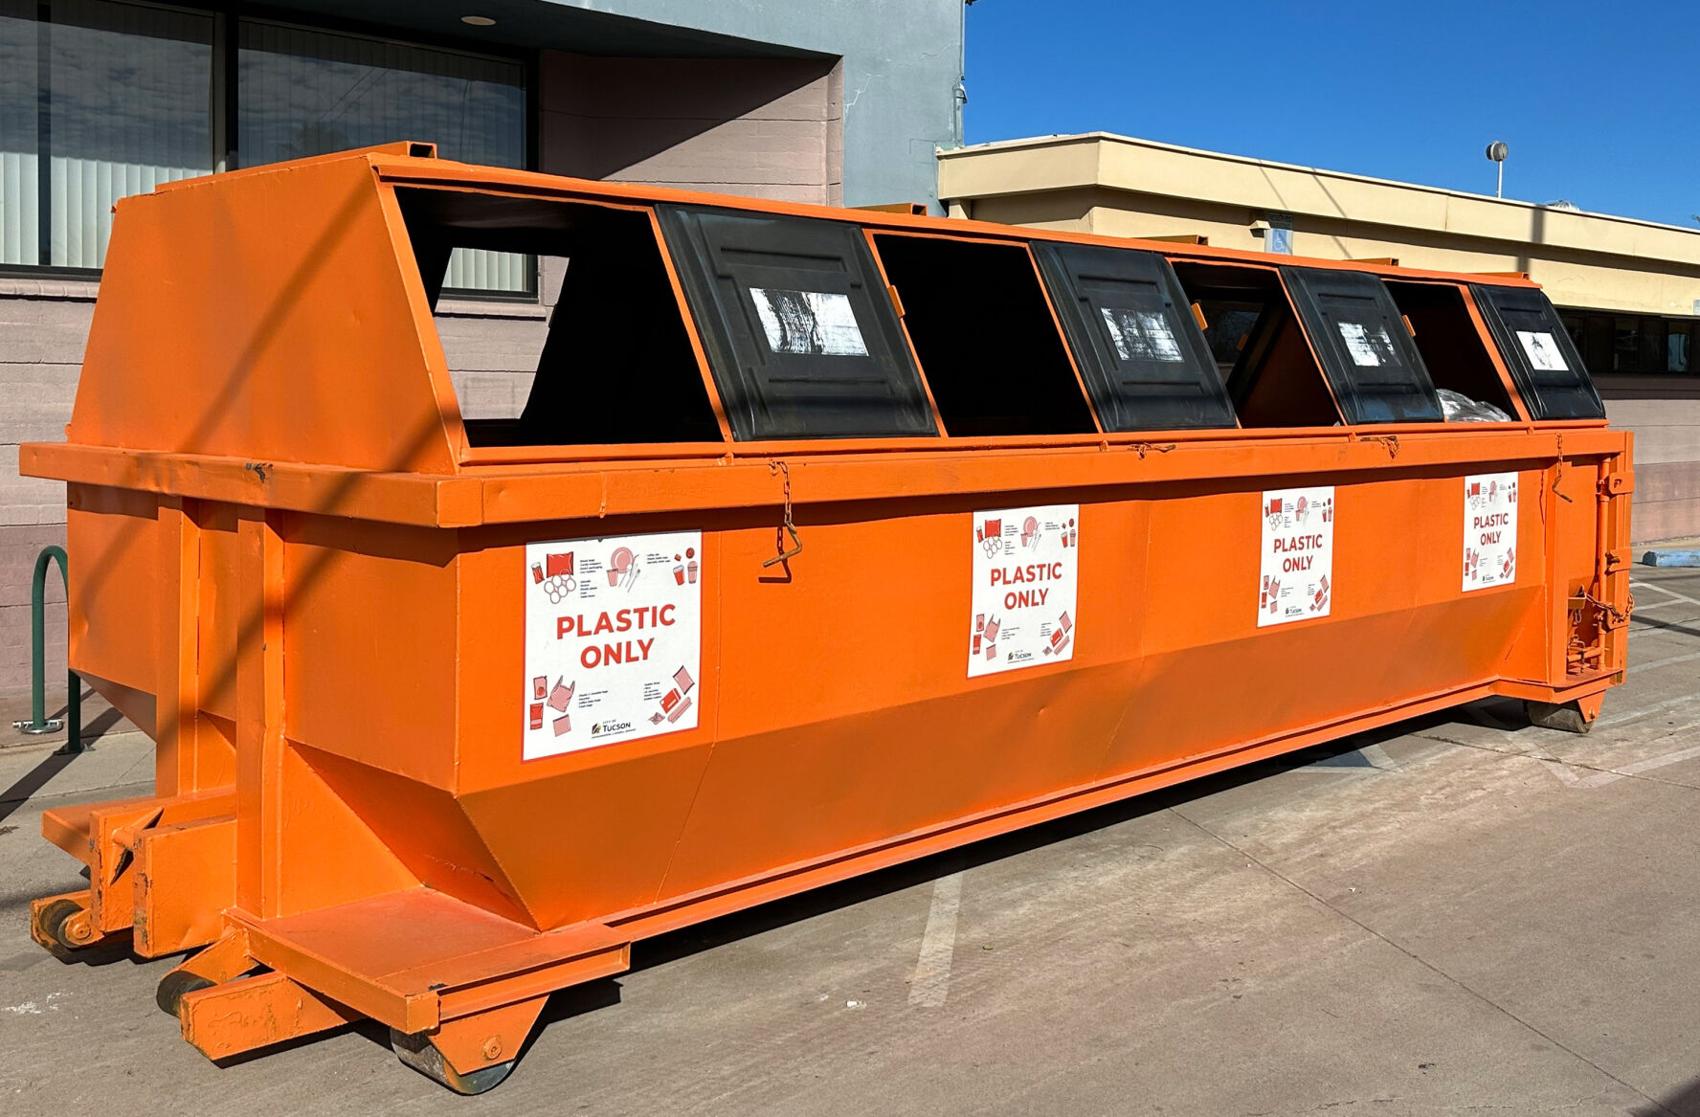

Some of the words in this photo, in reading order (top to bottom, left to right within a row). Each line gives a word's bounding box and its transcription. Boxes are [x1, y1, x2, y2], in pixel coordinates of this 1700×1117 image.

[1473, 512, 1509, 530] PLASTIC
[1273, 534, 1323, 553] PLASTIC
[1480, 531, 1502, 546] ONLY
[1282, 555, 1313, 573] ONLY
[990, 561, 1063, 587] PLASTIC
[1004, 588, 1049, 610] ONLY
[556, 603, 676, 640] PLASTIC
[580, 637, 655, 669] ONLY
[602, 721, 631, 733] TUCSON
